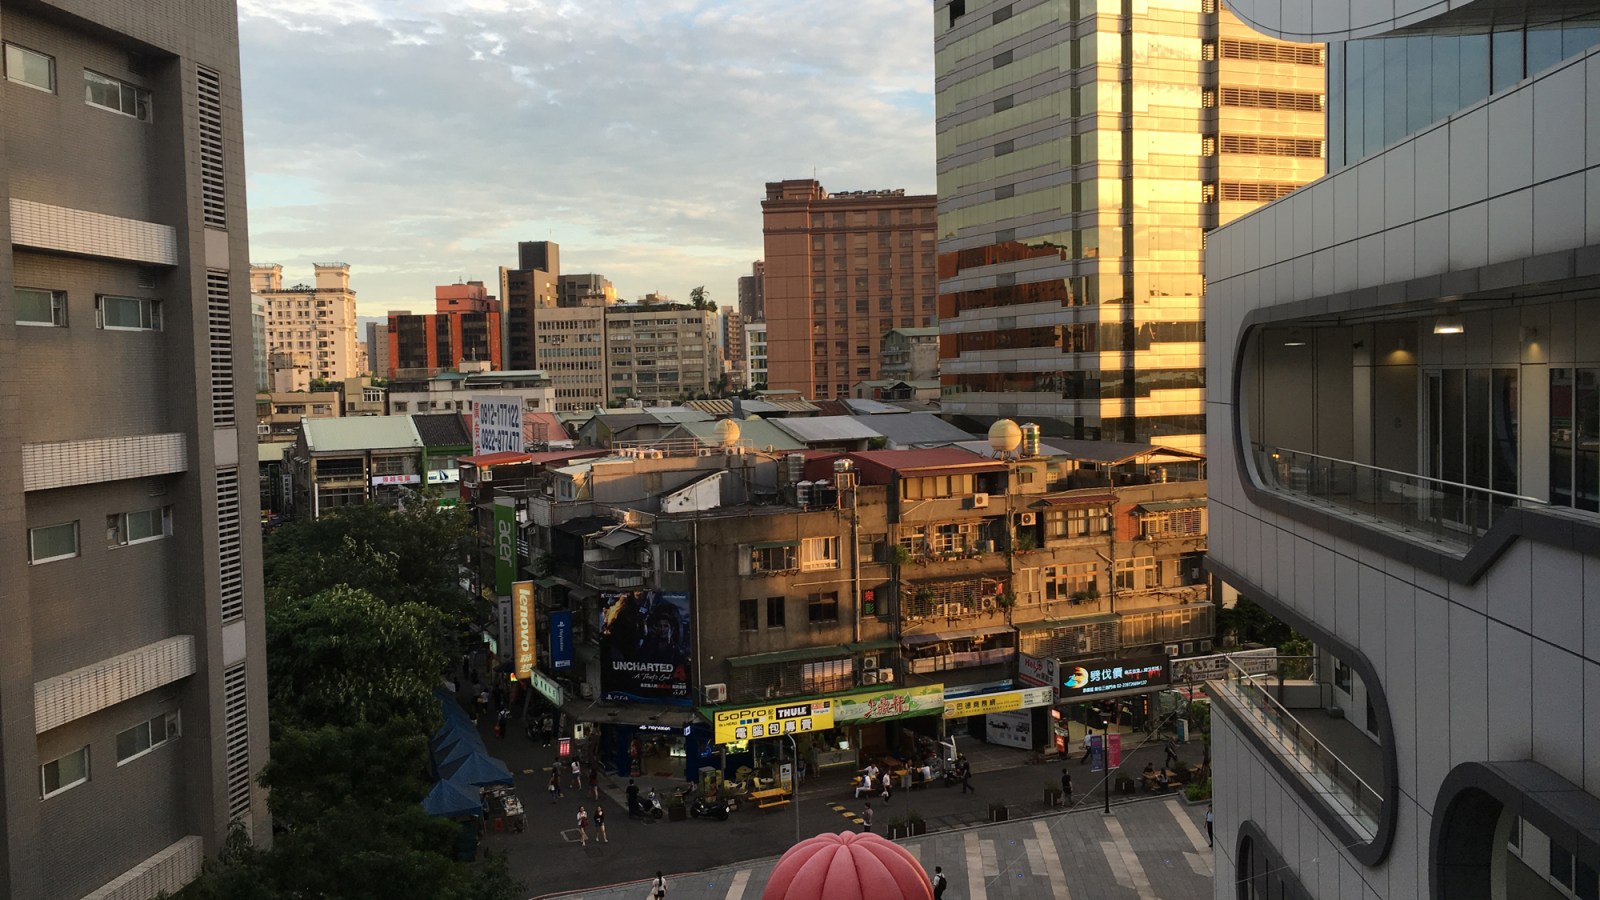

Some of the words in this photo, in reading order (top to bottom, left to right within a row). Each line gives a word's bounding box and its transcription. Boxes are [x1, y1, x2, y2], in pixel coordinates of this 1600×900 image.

[480, 403, 519, 428] 0912-177122
[481, 429, 519, 451] 0922-977477
[499, 520, 512, 568] acer
[519, 589, 530, 652] lenovo
[612, 661, 674, 672] UNCHARTED
[717, 709, 767, 722] GoPro
[777, 706, 808, 719] THULE
[735, 718, 812, 740] 電腦包專賣
